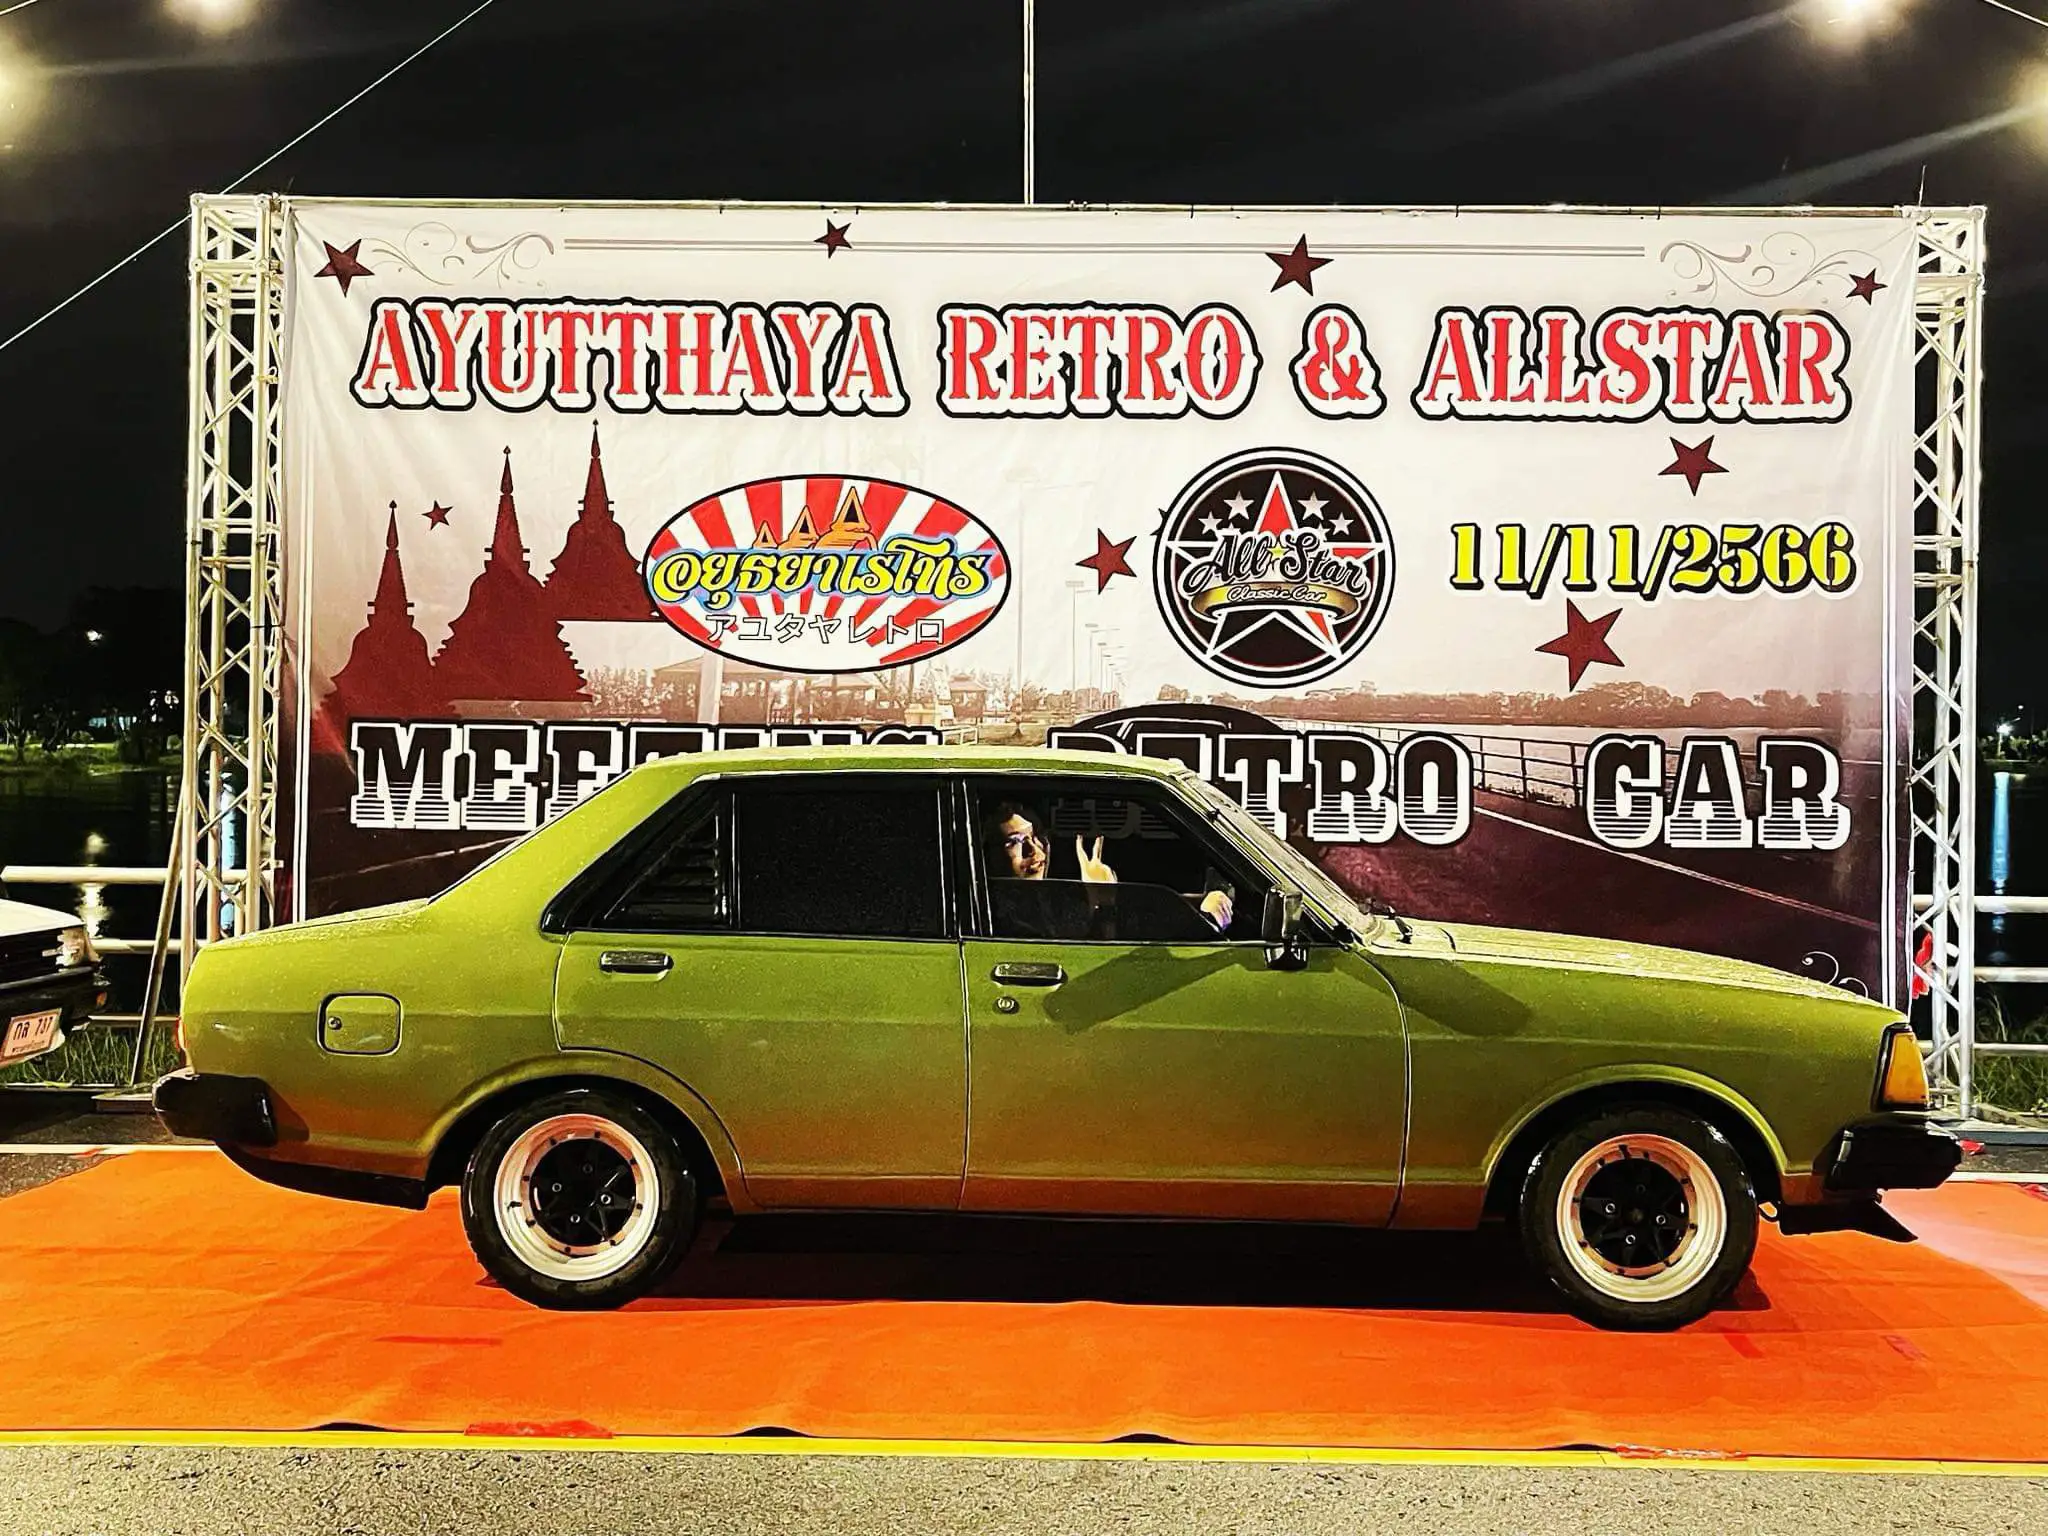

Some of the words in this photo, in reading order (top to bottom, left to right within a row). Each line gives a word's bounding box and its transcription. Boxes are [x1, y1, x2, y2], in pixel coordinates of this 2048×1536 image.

[355, 303, 902, 407] AYUTTHAYA
[943, 308, 1254, 409] RETRO
[1296, 310, 1376, 410] &
[1418, 312, 1844, 414] ALLSTAR
[651, 536, 990, 610] อยุธยาเรโทร
[1183, 532, 1271, 594] All
[1279, 532, 1368, 594] Star
[1227, 586, 1292, 602] Classic
[1292, 586, 1327, 602] Car
[1450, 522, 1857, 601] 11/11/2566
[705, 613, 946, 645] アユタヤレトロ
[1586, 738, 1851, 850] CAR
